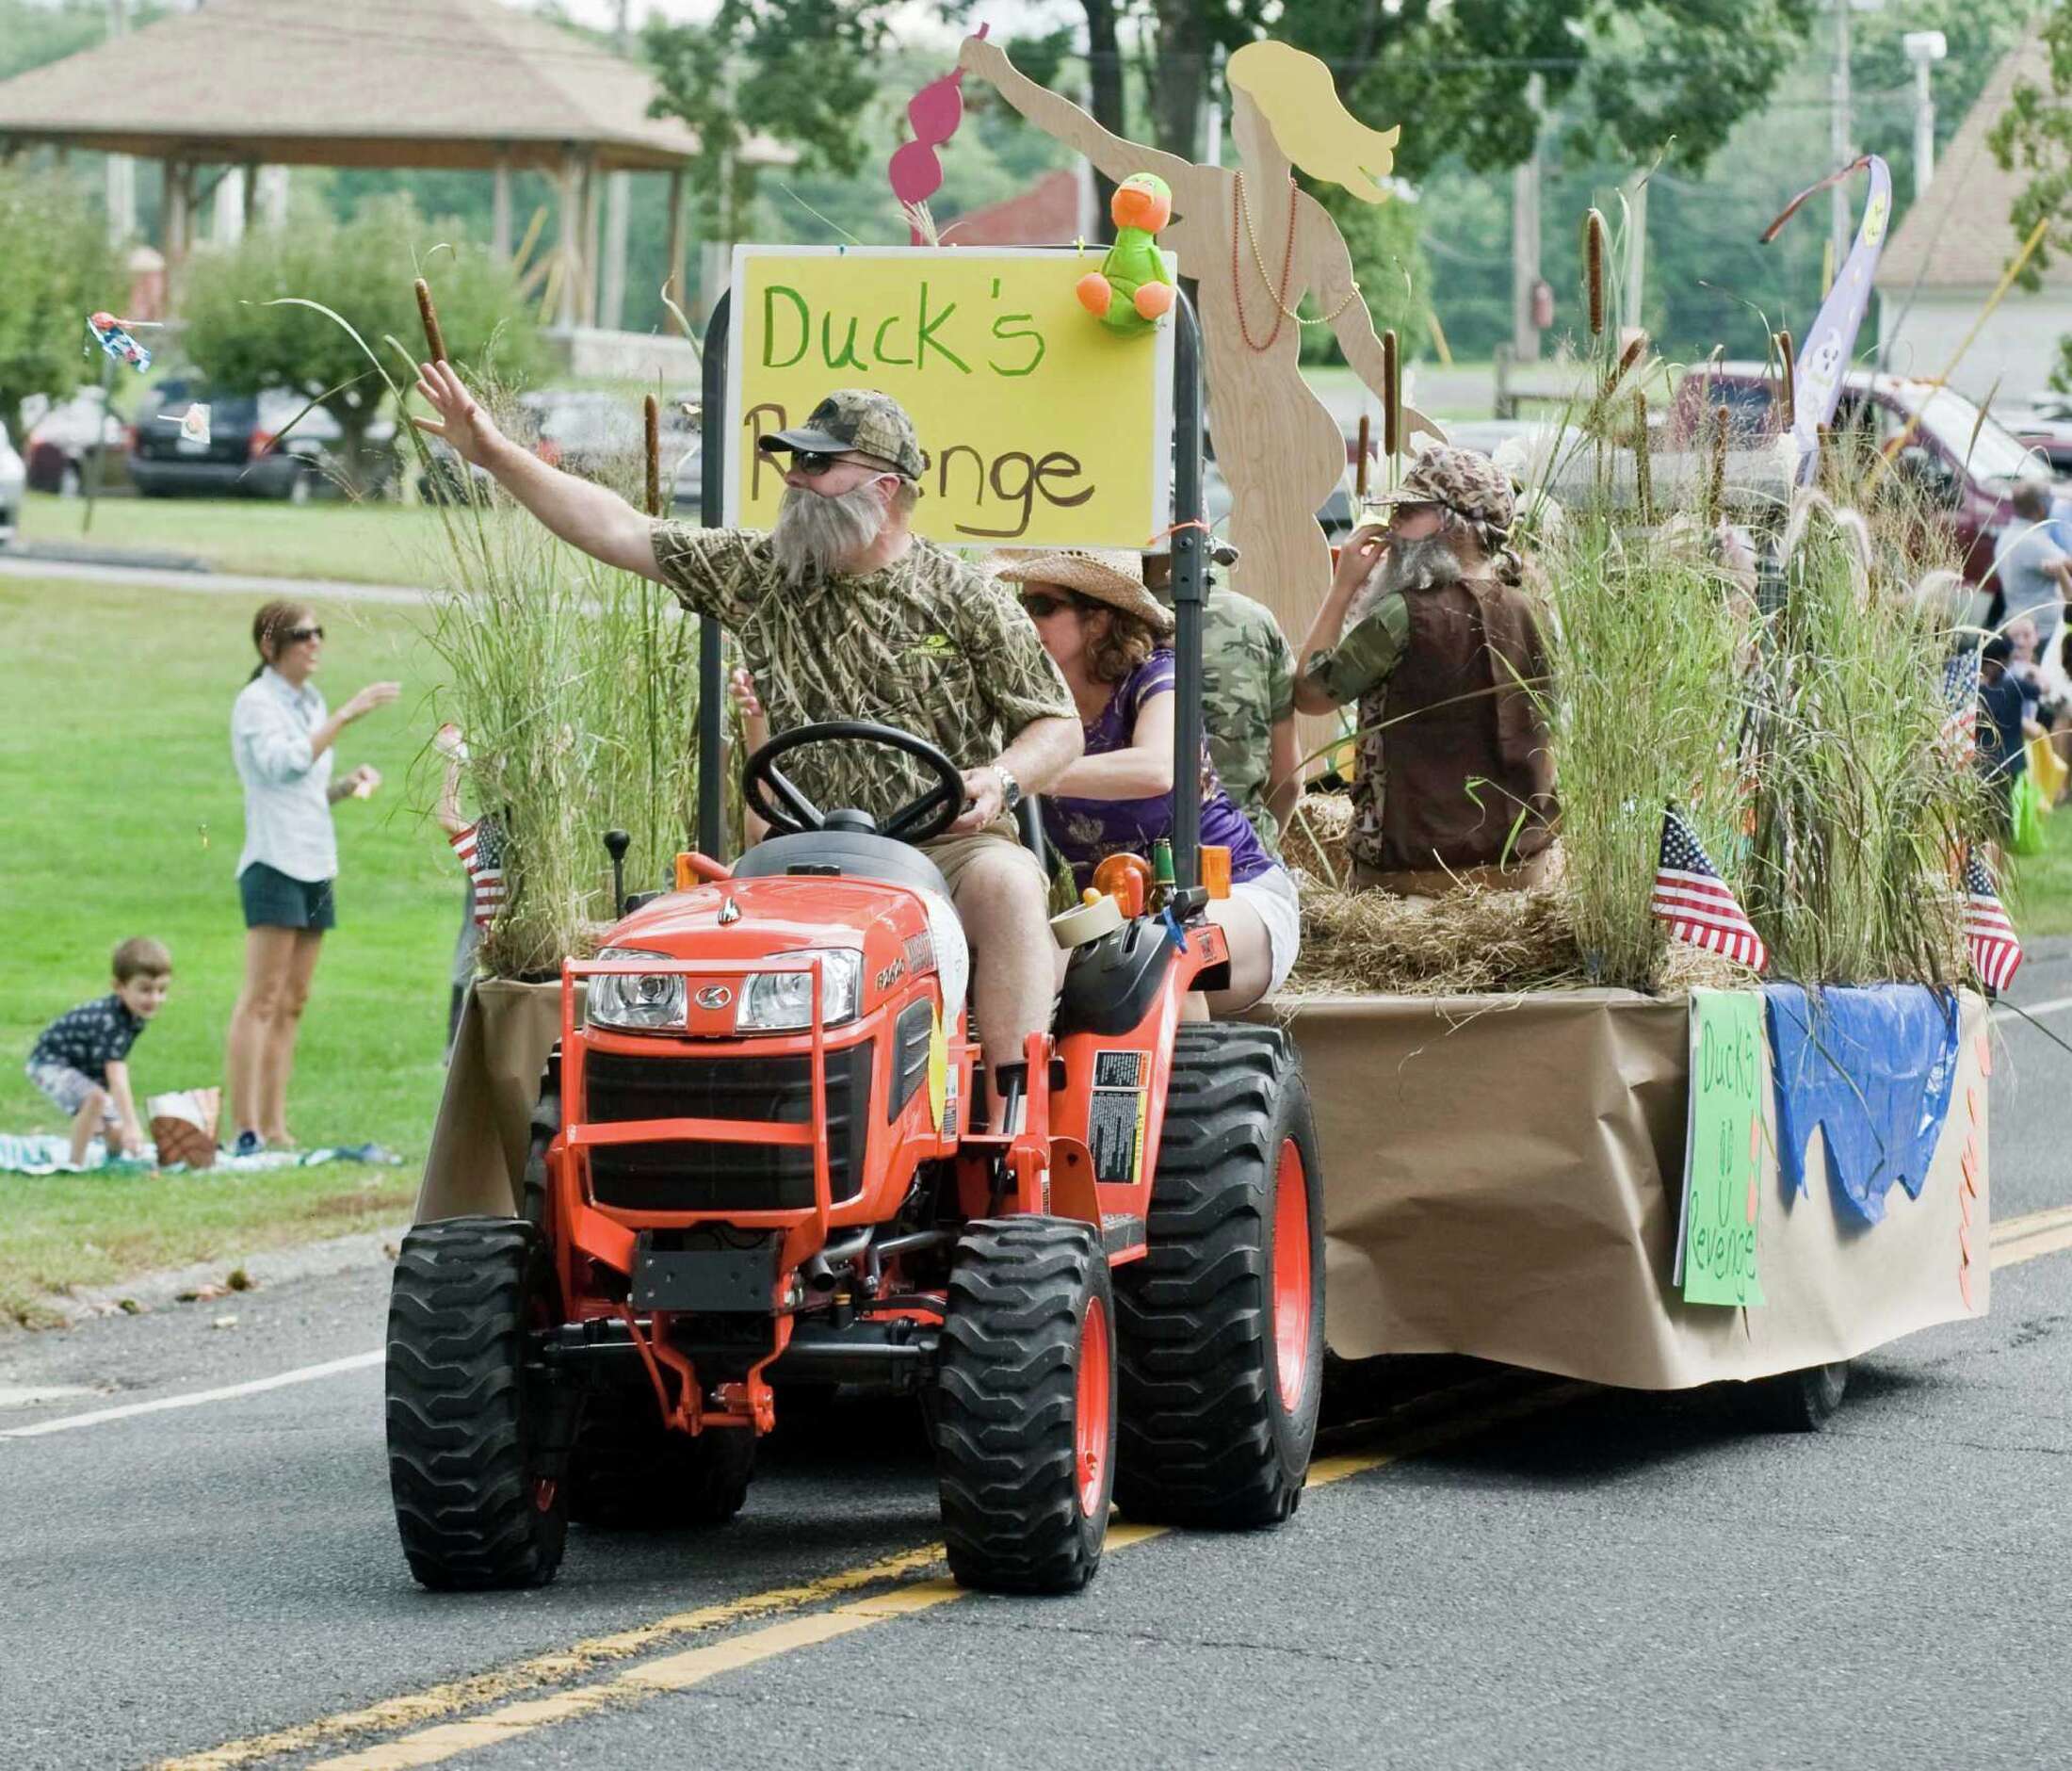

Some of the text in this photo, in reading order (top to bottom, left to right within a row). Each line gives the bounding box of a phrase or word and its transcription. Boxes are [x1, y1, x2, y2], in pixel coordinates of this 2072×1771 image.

[762, 278, 1046, 377] Duck's
[743, 402, 1095, 538] Rnge
[1688, 1191, 1756, 1302] Revenge
